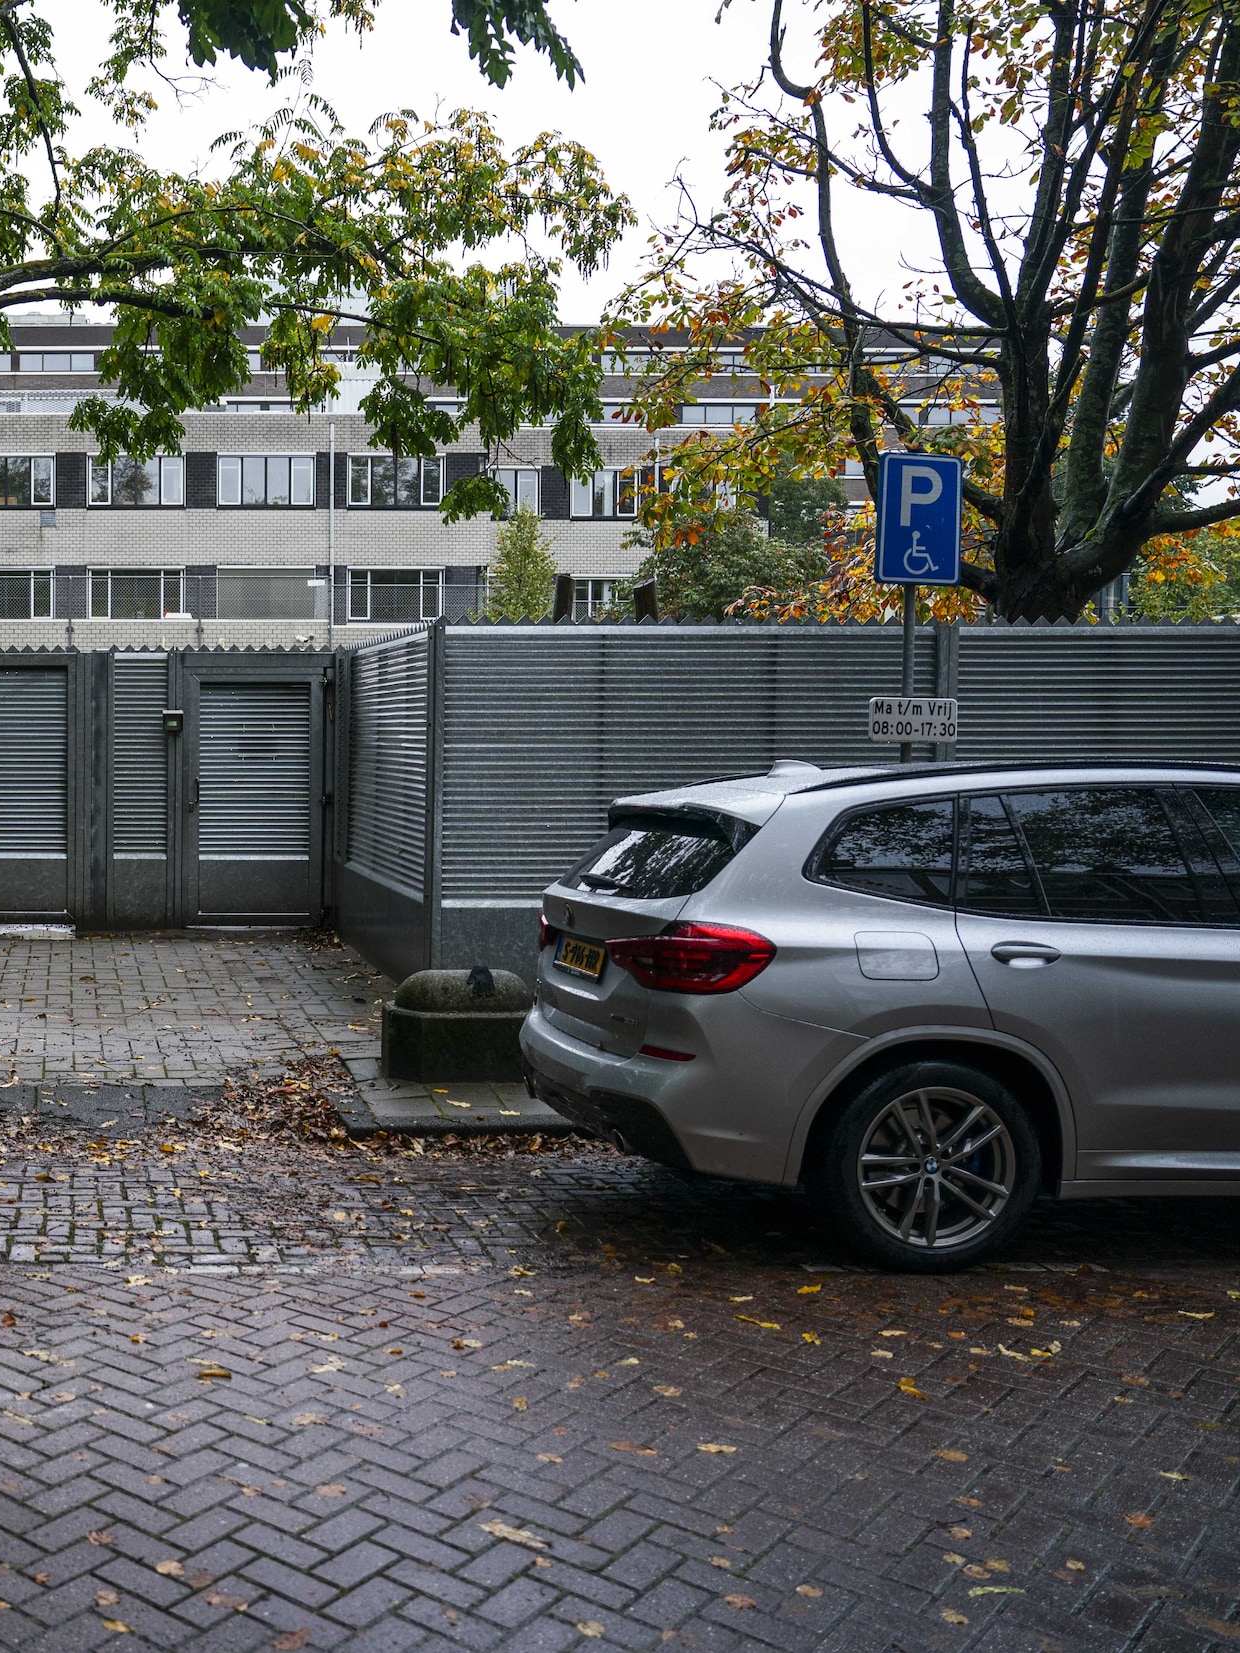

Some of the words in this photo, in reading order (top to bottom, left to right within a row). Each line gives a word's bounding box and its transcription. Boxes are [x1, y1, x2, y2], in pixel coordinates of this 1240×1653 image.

[900, 465, 943, 526] P
[874, 701, 892, 714] Ma
[898, 700, 922, 715] t/m
[928, 701, 952, 720] Vrij
[872, 721, 956, 736] 08:00-17:30
